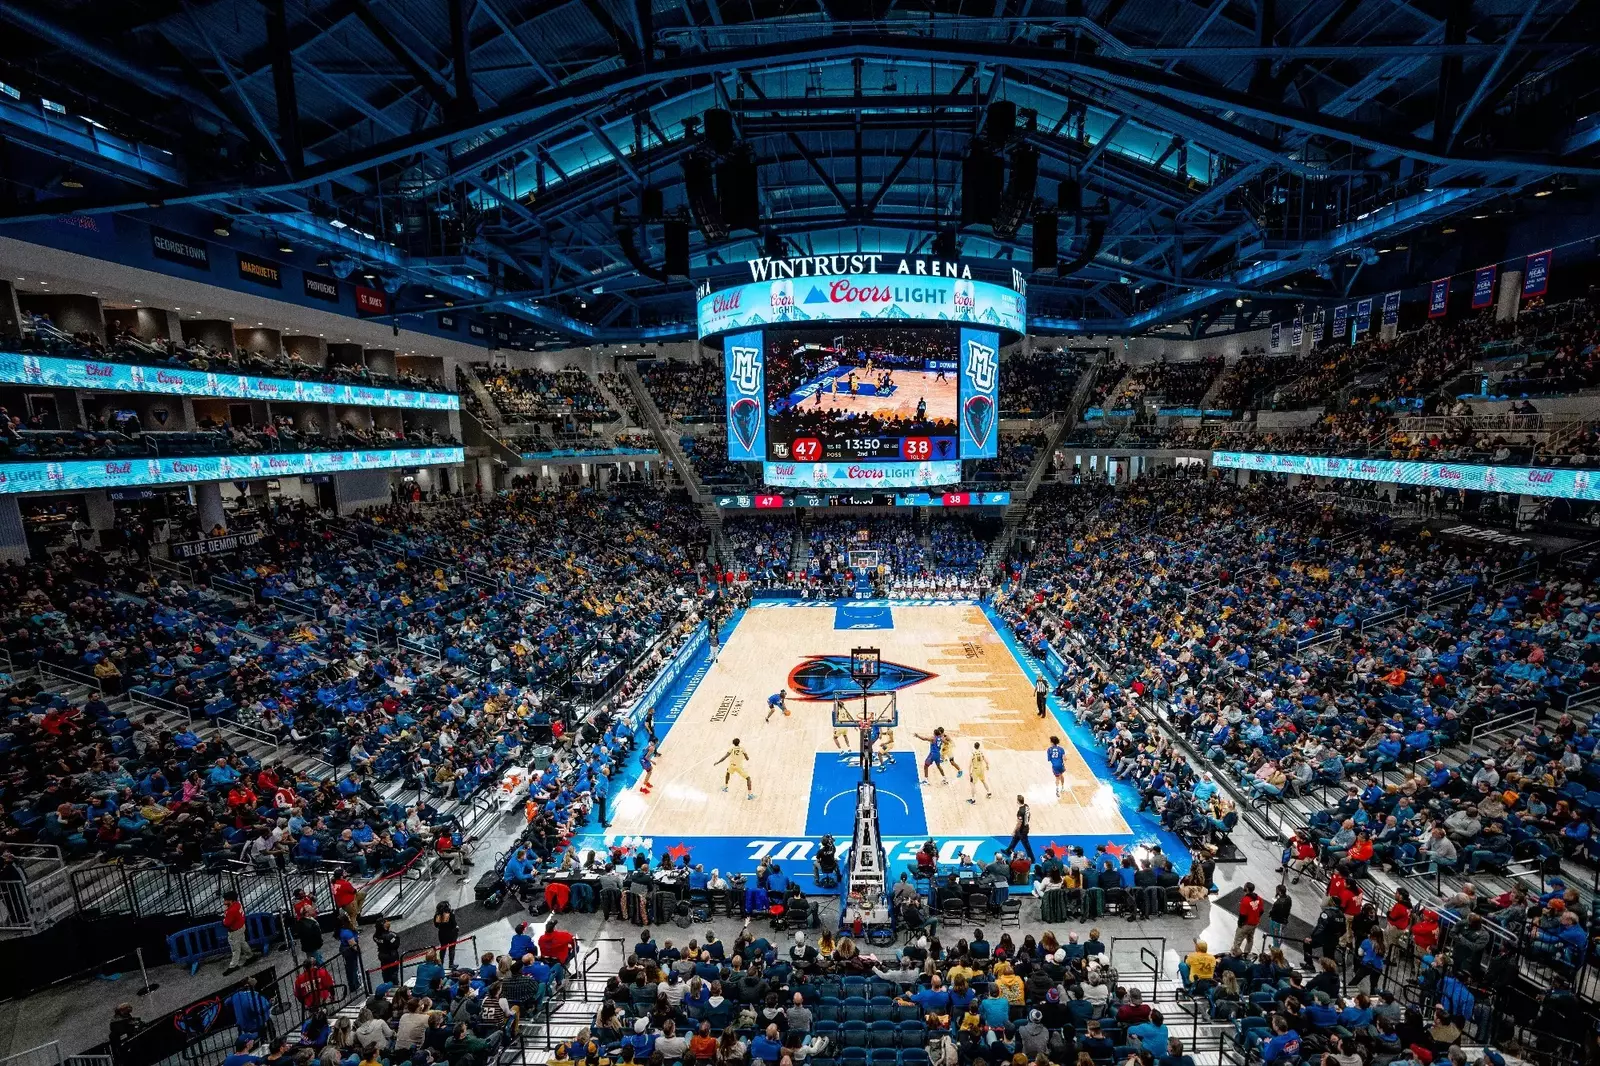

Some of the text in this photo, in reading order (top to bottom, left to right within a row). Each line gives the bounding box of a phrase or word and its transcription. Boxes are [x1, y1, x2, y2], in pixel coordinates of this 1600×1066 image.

[154, 236, 207, 261] GEORGETOWN
[241, 260, 278, 280] MARQUETTE
[748, 254, 972, 283] WINTRUST ARENA
[306, 279, 336, 296] PROVIDENCE
[829, 279, 946, 304] Coors LIGHT
[713, 288, 742, 314] Chill
[770, 292, 794, 306] Coors
[772, 306, 793, 315] LIGHT
[157, 371, 183, 386] Coors
[796, 441, 817, 455] 47
[845, 438, 880, 450] 13:50
[907, 441, 928, 454] 38
[106, 462, 132, 475] Chill
[172, 461, 198, 474] Coors
[848, 465, 915, 479] Coors LIGHT
[1440, 465, 1461, 480] Coors
[1528, 470, 1555, 483] Chill
[140, 491, 153, 499] 109
[762, 497, 773, 506] 47
[950, 495, 960, 503] 38
[182, 541, 205, 558] BLUE
[208, 536, 237, 552] DEMON
[1051, 751, 1059, 759] 23
[746, 838, 985, 865] DEAUL
[482, 1007, 496, 1020] 22
